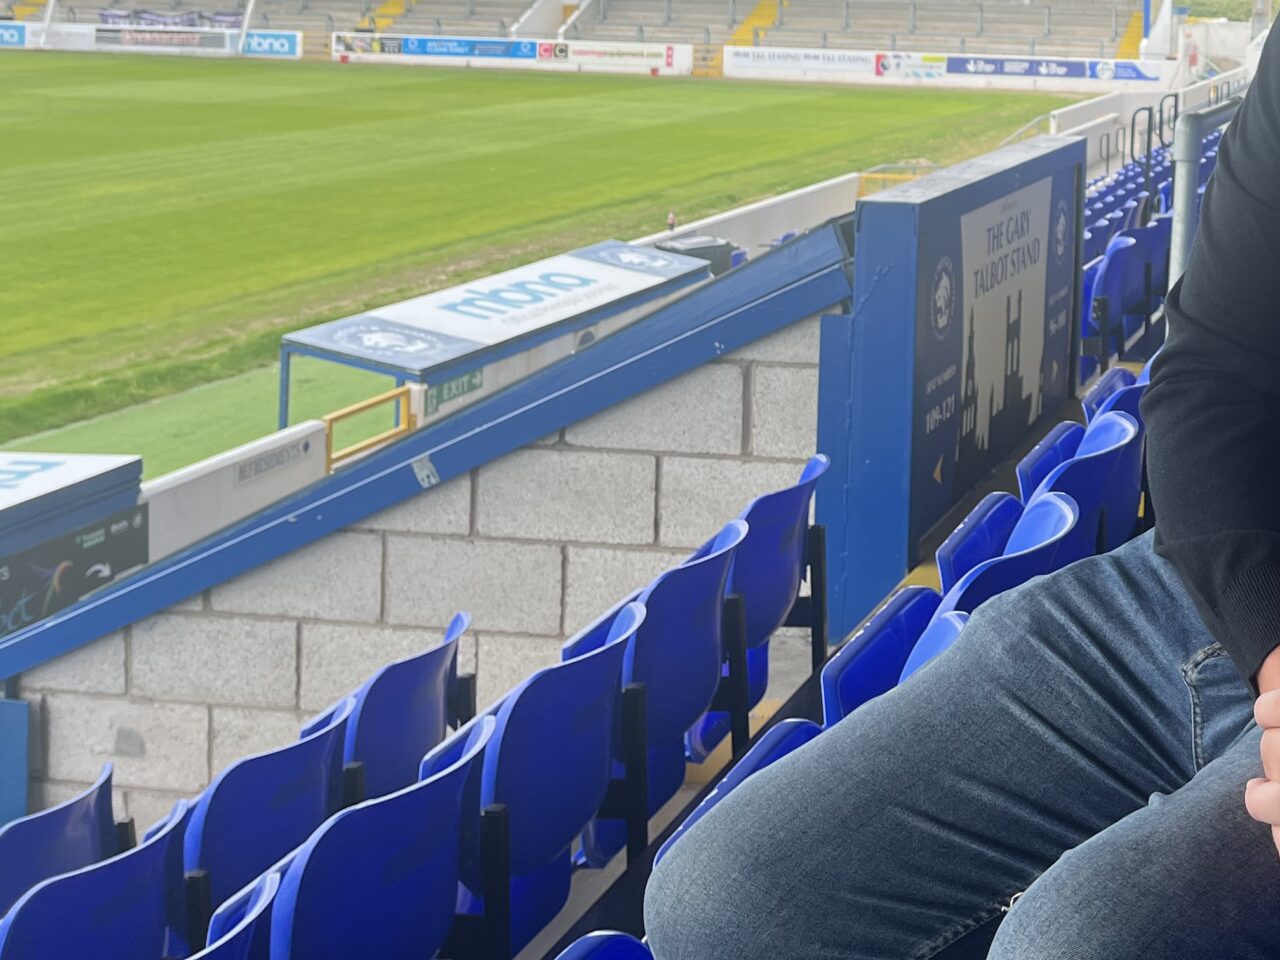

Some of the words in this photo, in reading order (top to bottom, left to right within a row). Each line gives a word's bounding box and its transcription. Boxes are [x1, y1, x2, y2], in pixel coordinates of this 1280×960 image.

[0, 28, 18, 42] na
[986, 222, 1004, 256] THE
[1007, 209, 1033, 245] GARY
[974, 254, 1010, 299] TALBOT
[1011, 238, 1040, 277] STAND
[437, 272, 597, 319] mbna
[443, 374, 470, 400] EXIT
